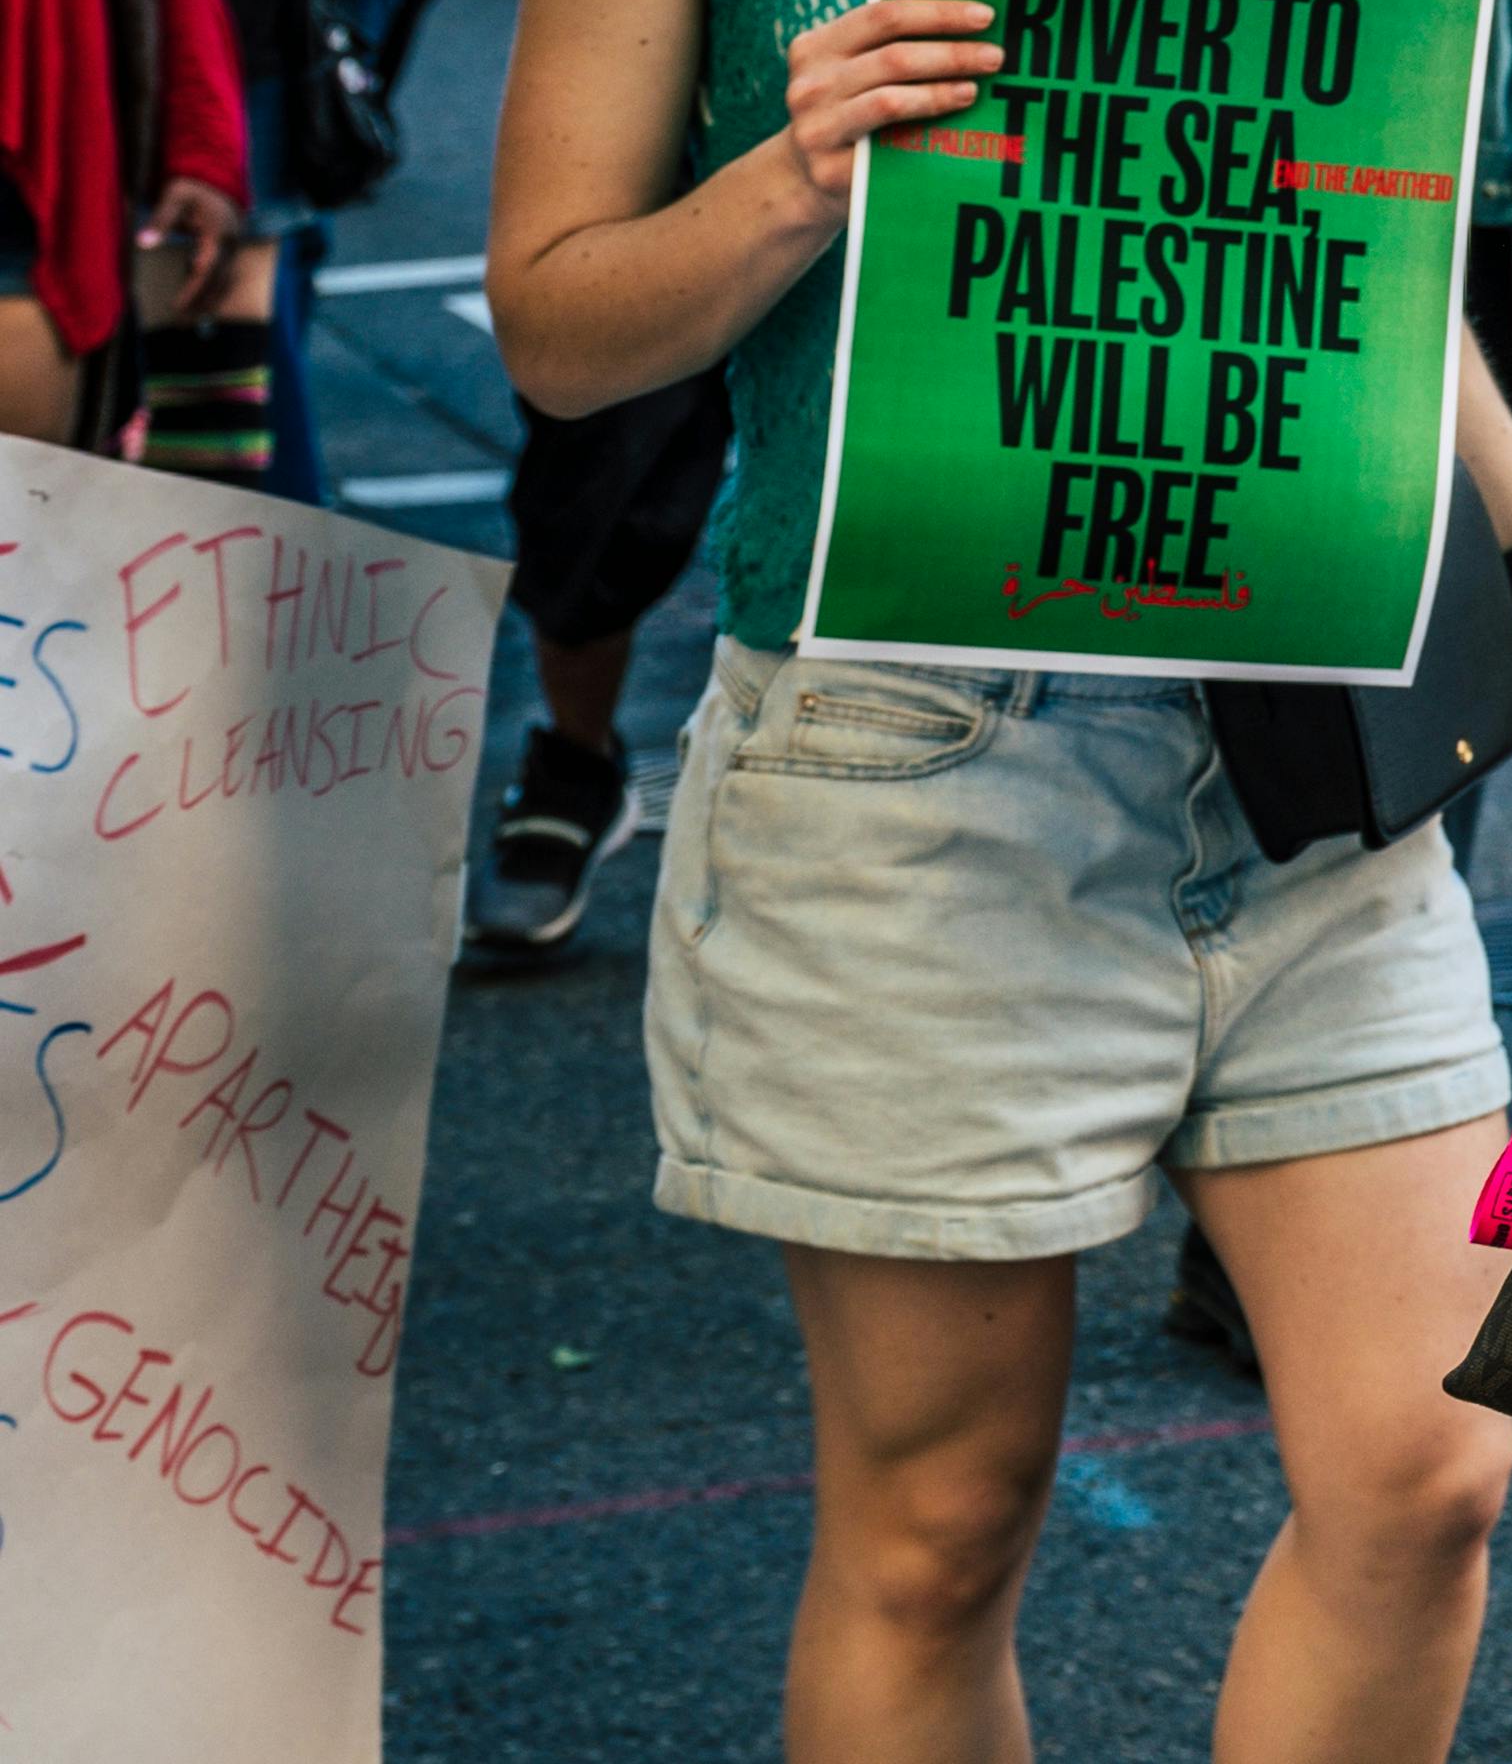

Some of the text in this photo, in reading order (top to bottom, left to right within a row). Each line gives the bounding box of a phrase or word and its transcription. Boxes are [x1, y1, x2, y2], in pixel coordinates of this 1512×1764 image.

[927, 125, 1026, 165] PALESTINE
[991, 83, 1322, 241] THE SEA,
[1273, 159, 1454, 203] END THE APARTHEID
[947, 202, 1368, 353] PALESTINE
[996, 332, 1308, 472] WILL BE
[1037, 461, 1239, 592] FREE
[118, 526, 460, 718] ETHNIC
[94, 686, 486, 841] CLEANSING
[96, 976, 408, 1379] APARTHEID
[42, 1309, 384, 1636] GENOCIDE
